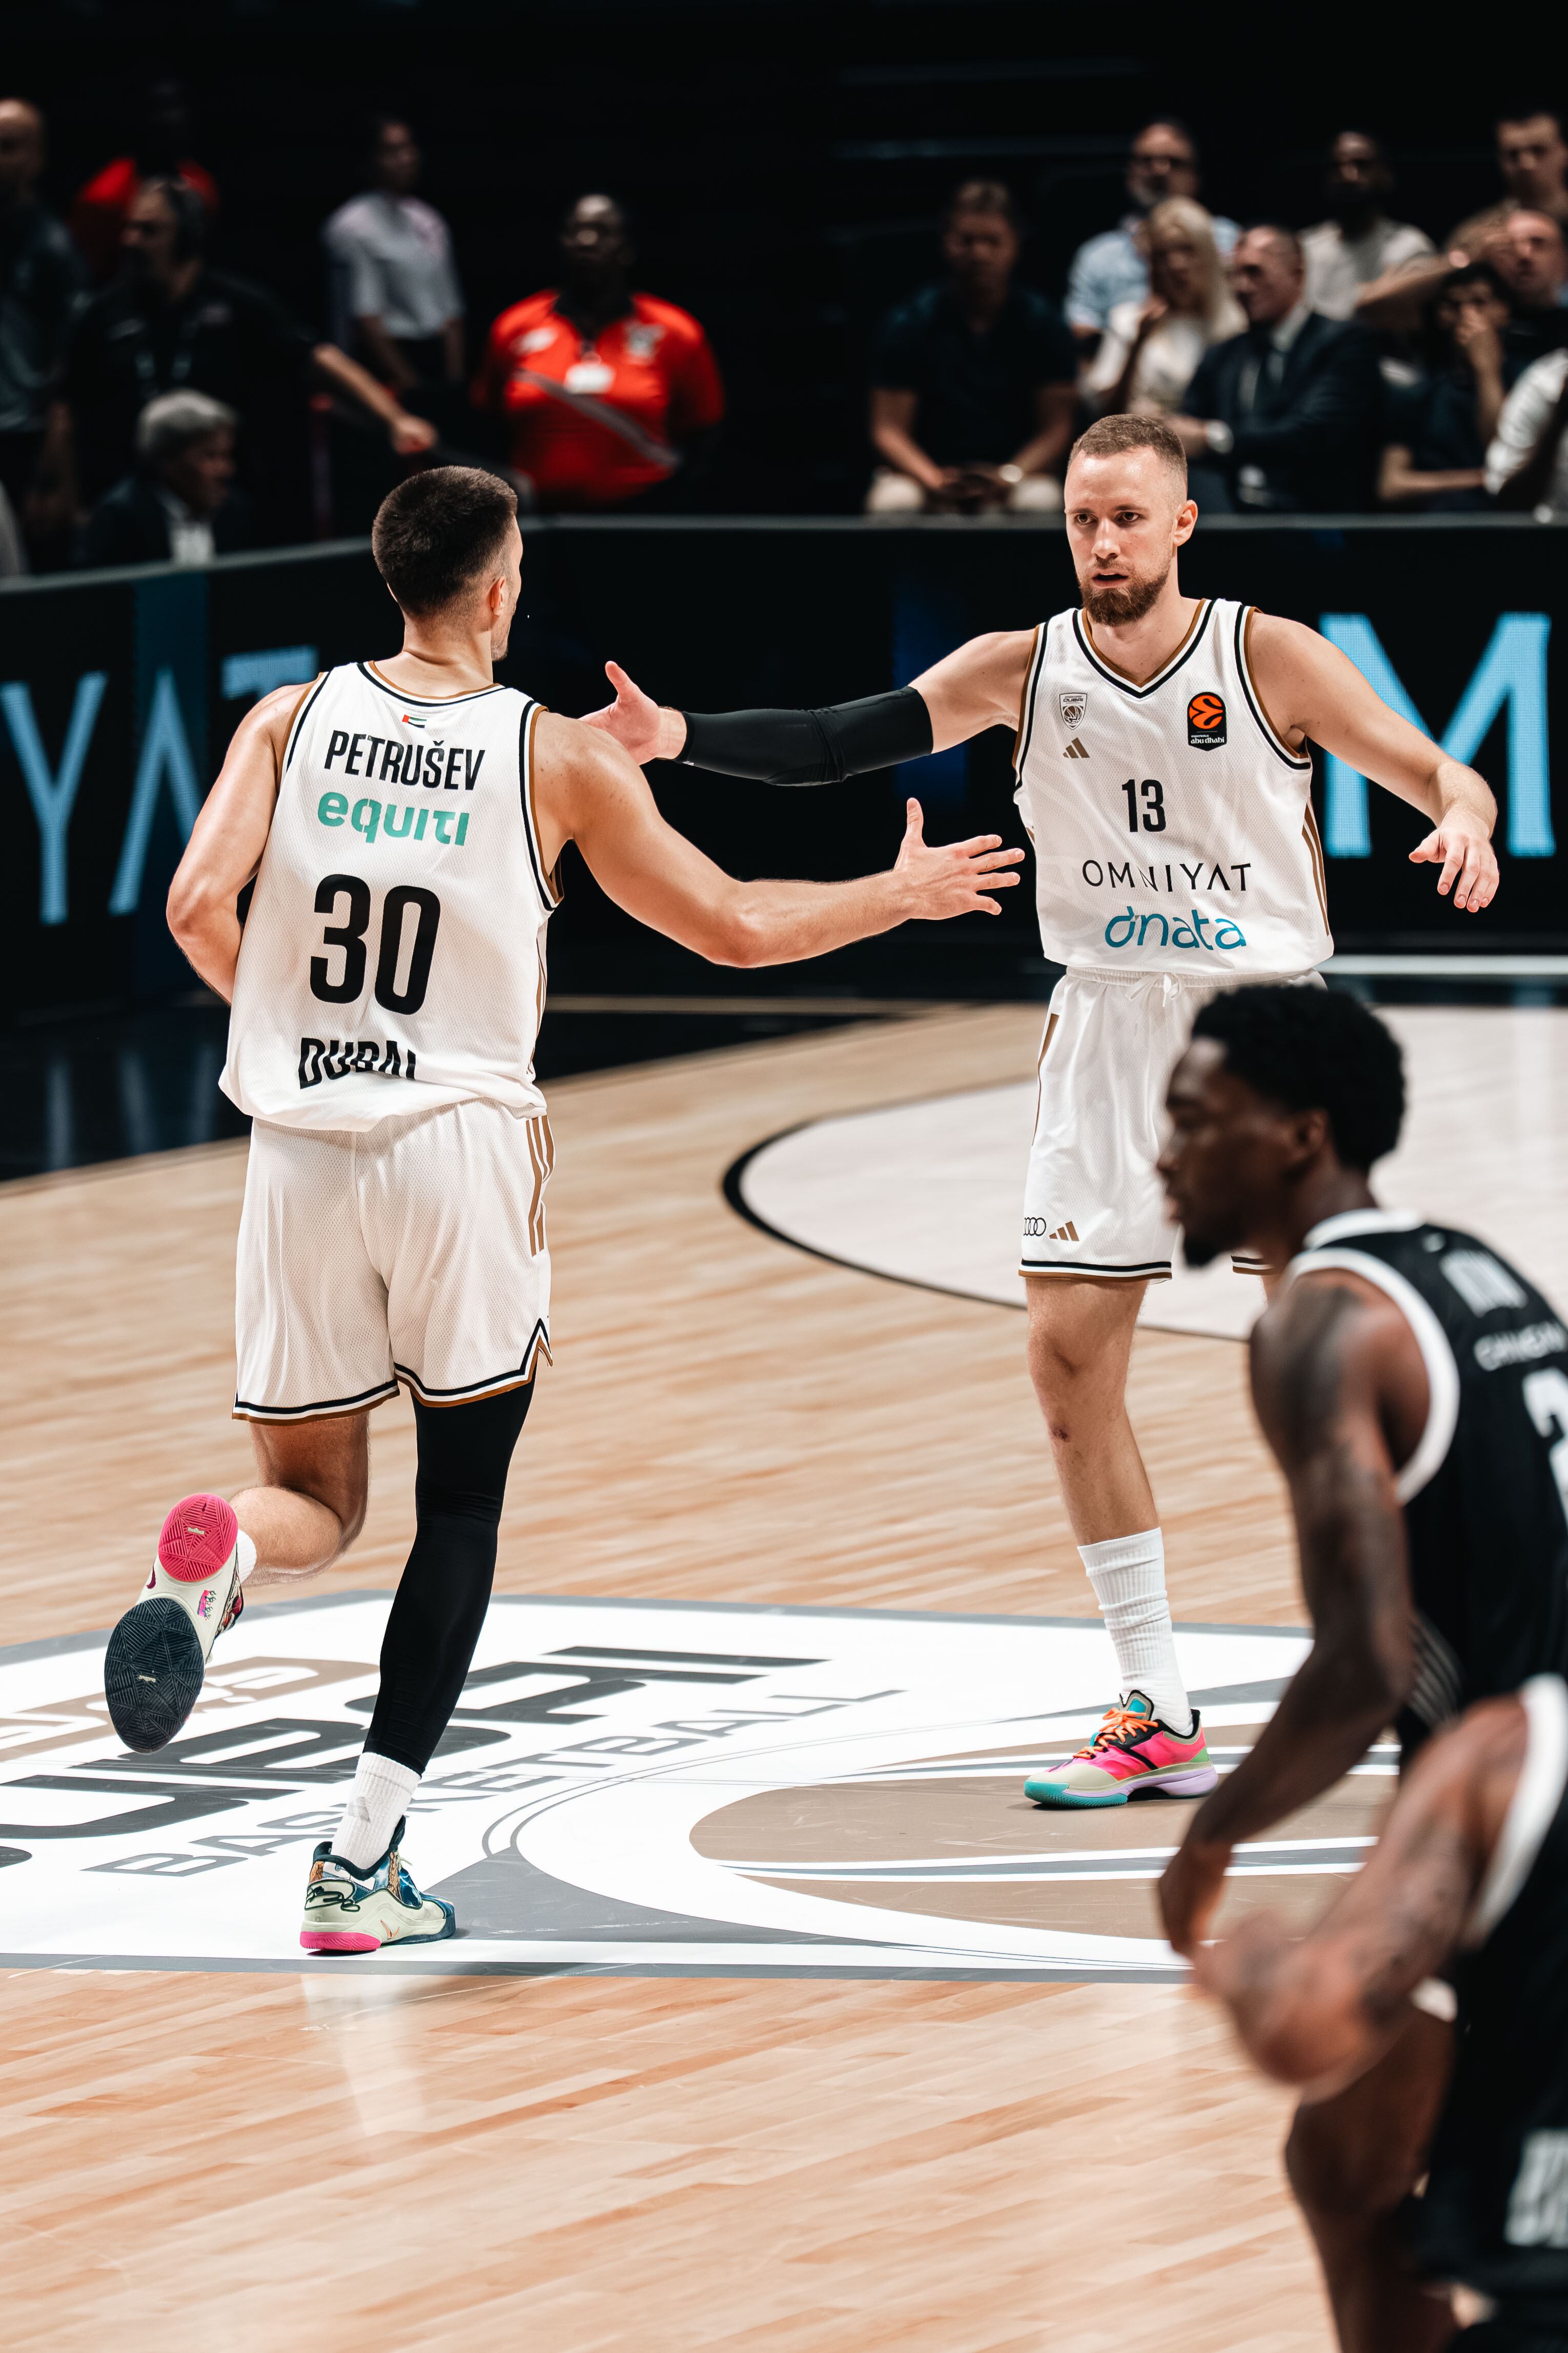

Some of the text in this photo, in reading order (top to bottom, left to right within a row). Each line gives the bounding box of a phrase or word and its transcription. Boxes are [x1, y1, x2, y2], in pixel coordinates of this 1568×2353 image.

[324, 729, 485, 791] PETRUŠEV
[317, 791, 471, 846] equiti
[1122, 779, 1166, 833] 13
[1082, 859, 1251, 892] OMNIYAT
[310, 874, 441, 1016] 30
[1105, 906, 1247, 951] dnata
[298, 1037, 416, 1090] DUBAI
